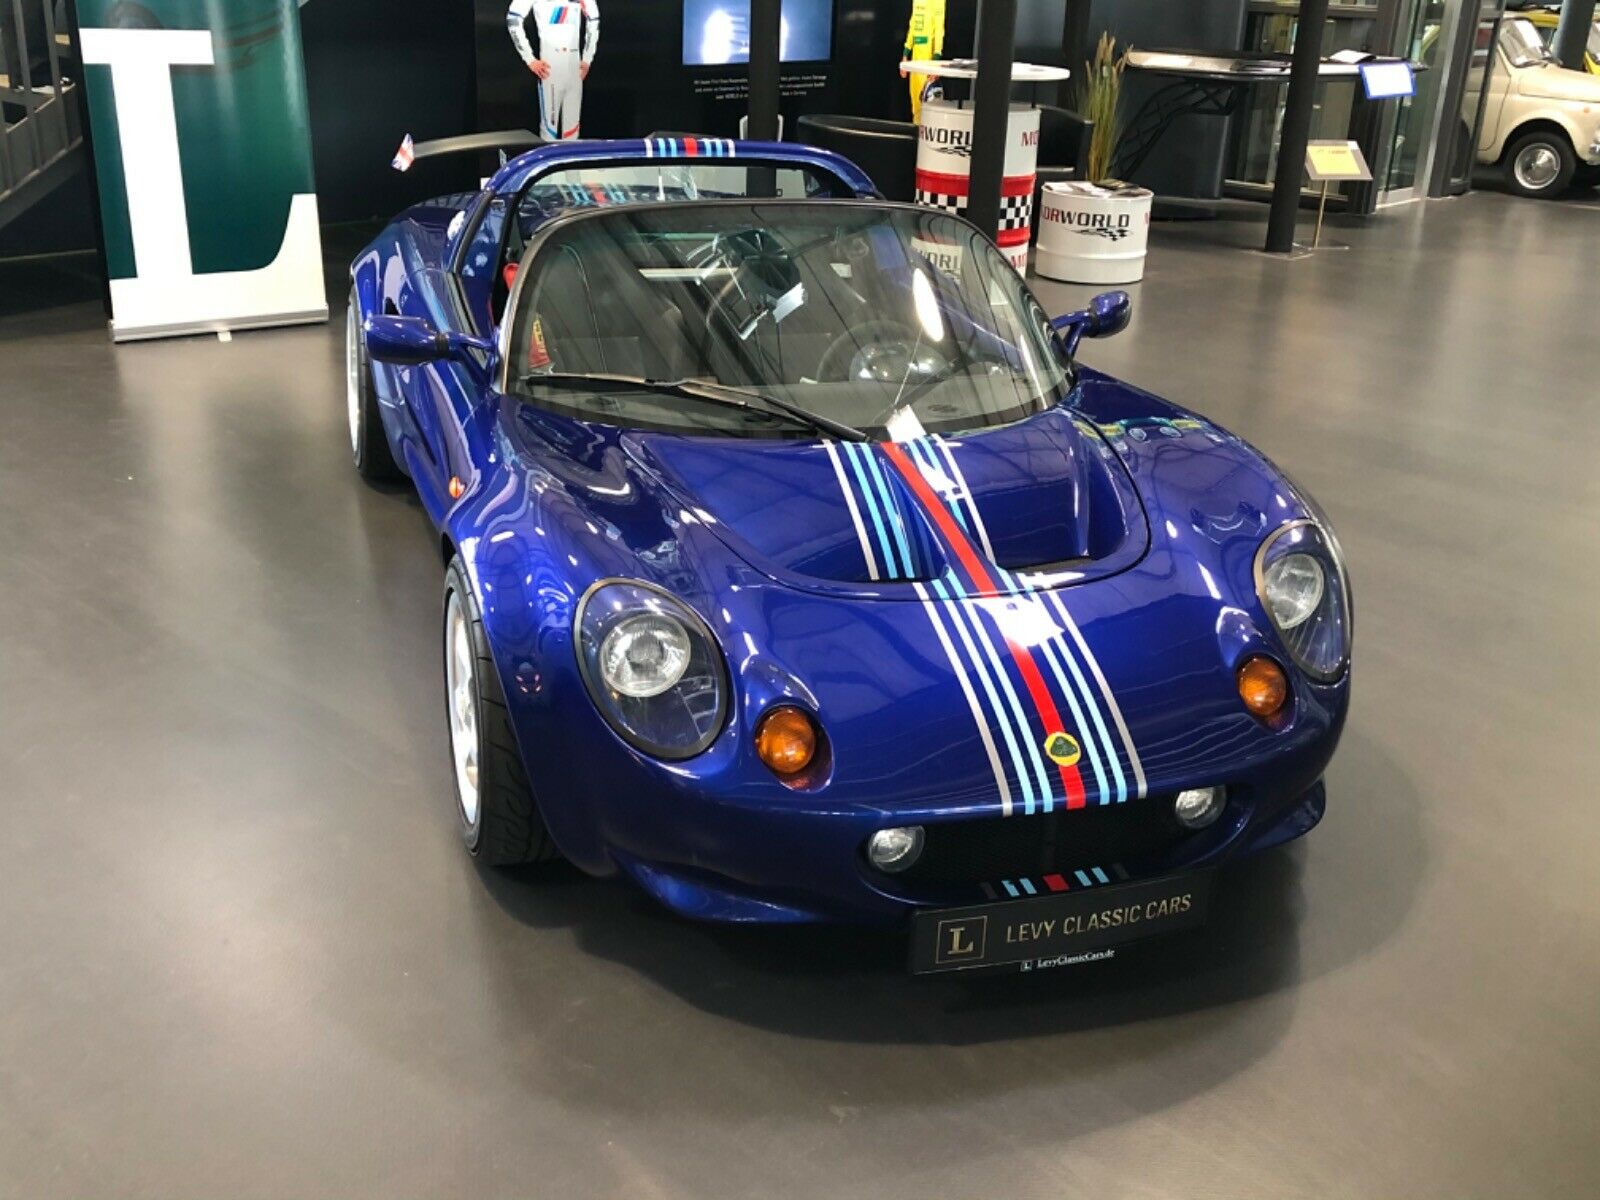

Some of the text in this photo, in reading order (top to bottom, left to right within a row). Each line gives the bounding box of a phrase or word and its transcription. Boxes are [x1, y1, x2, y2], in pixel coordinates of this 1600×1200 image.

[79, 28, 324, 325] L
[948, 927, 974, 955] L
[1007, 893, 1192, 944] LEVY CLASSIC CARS
